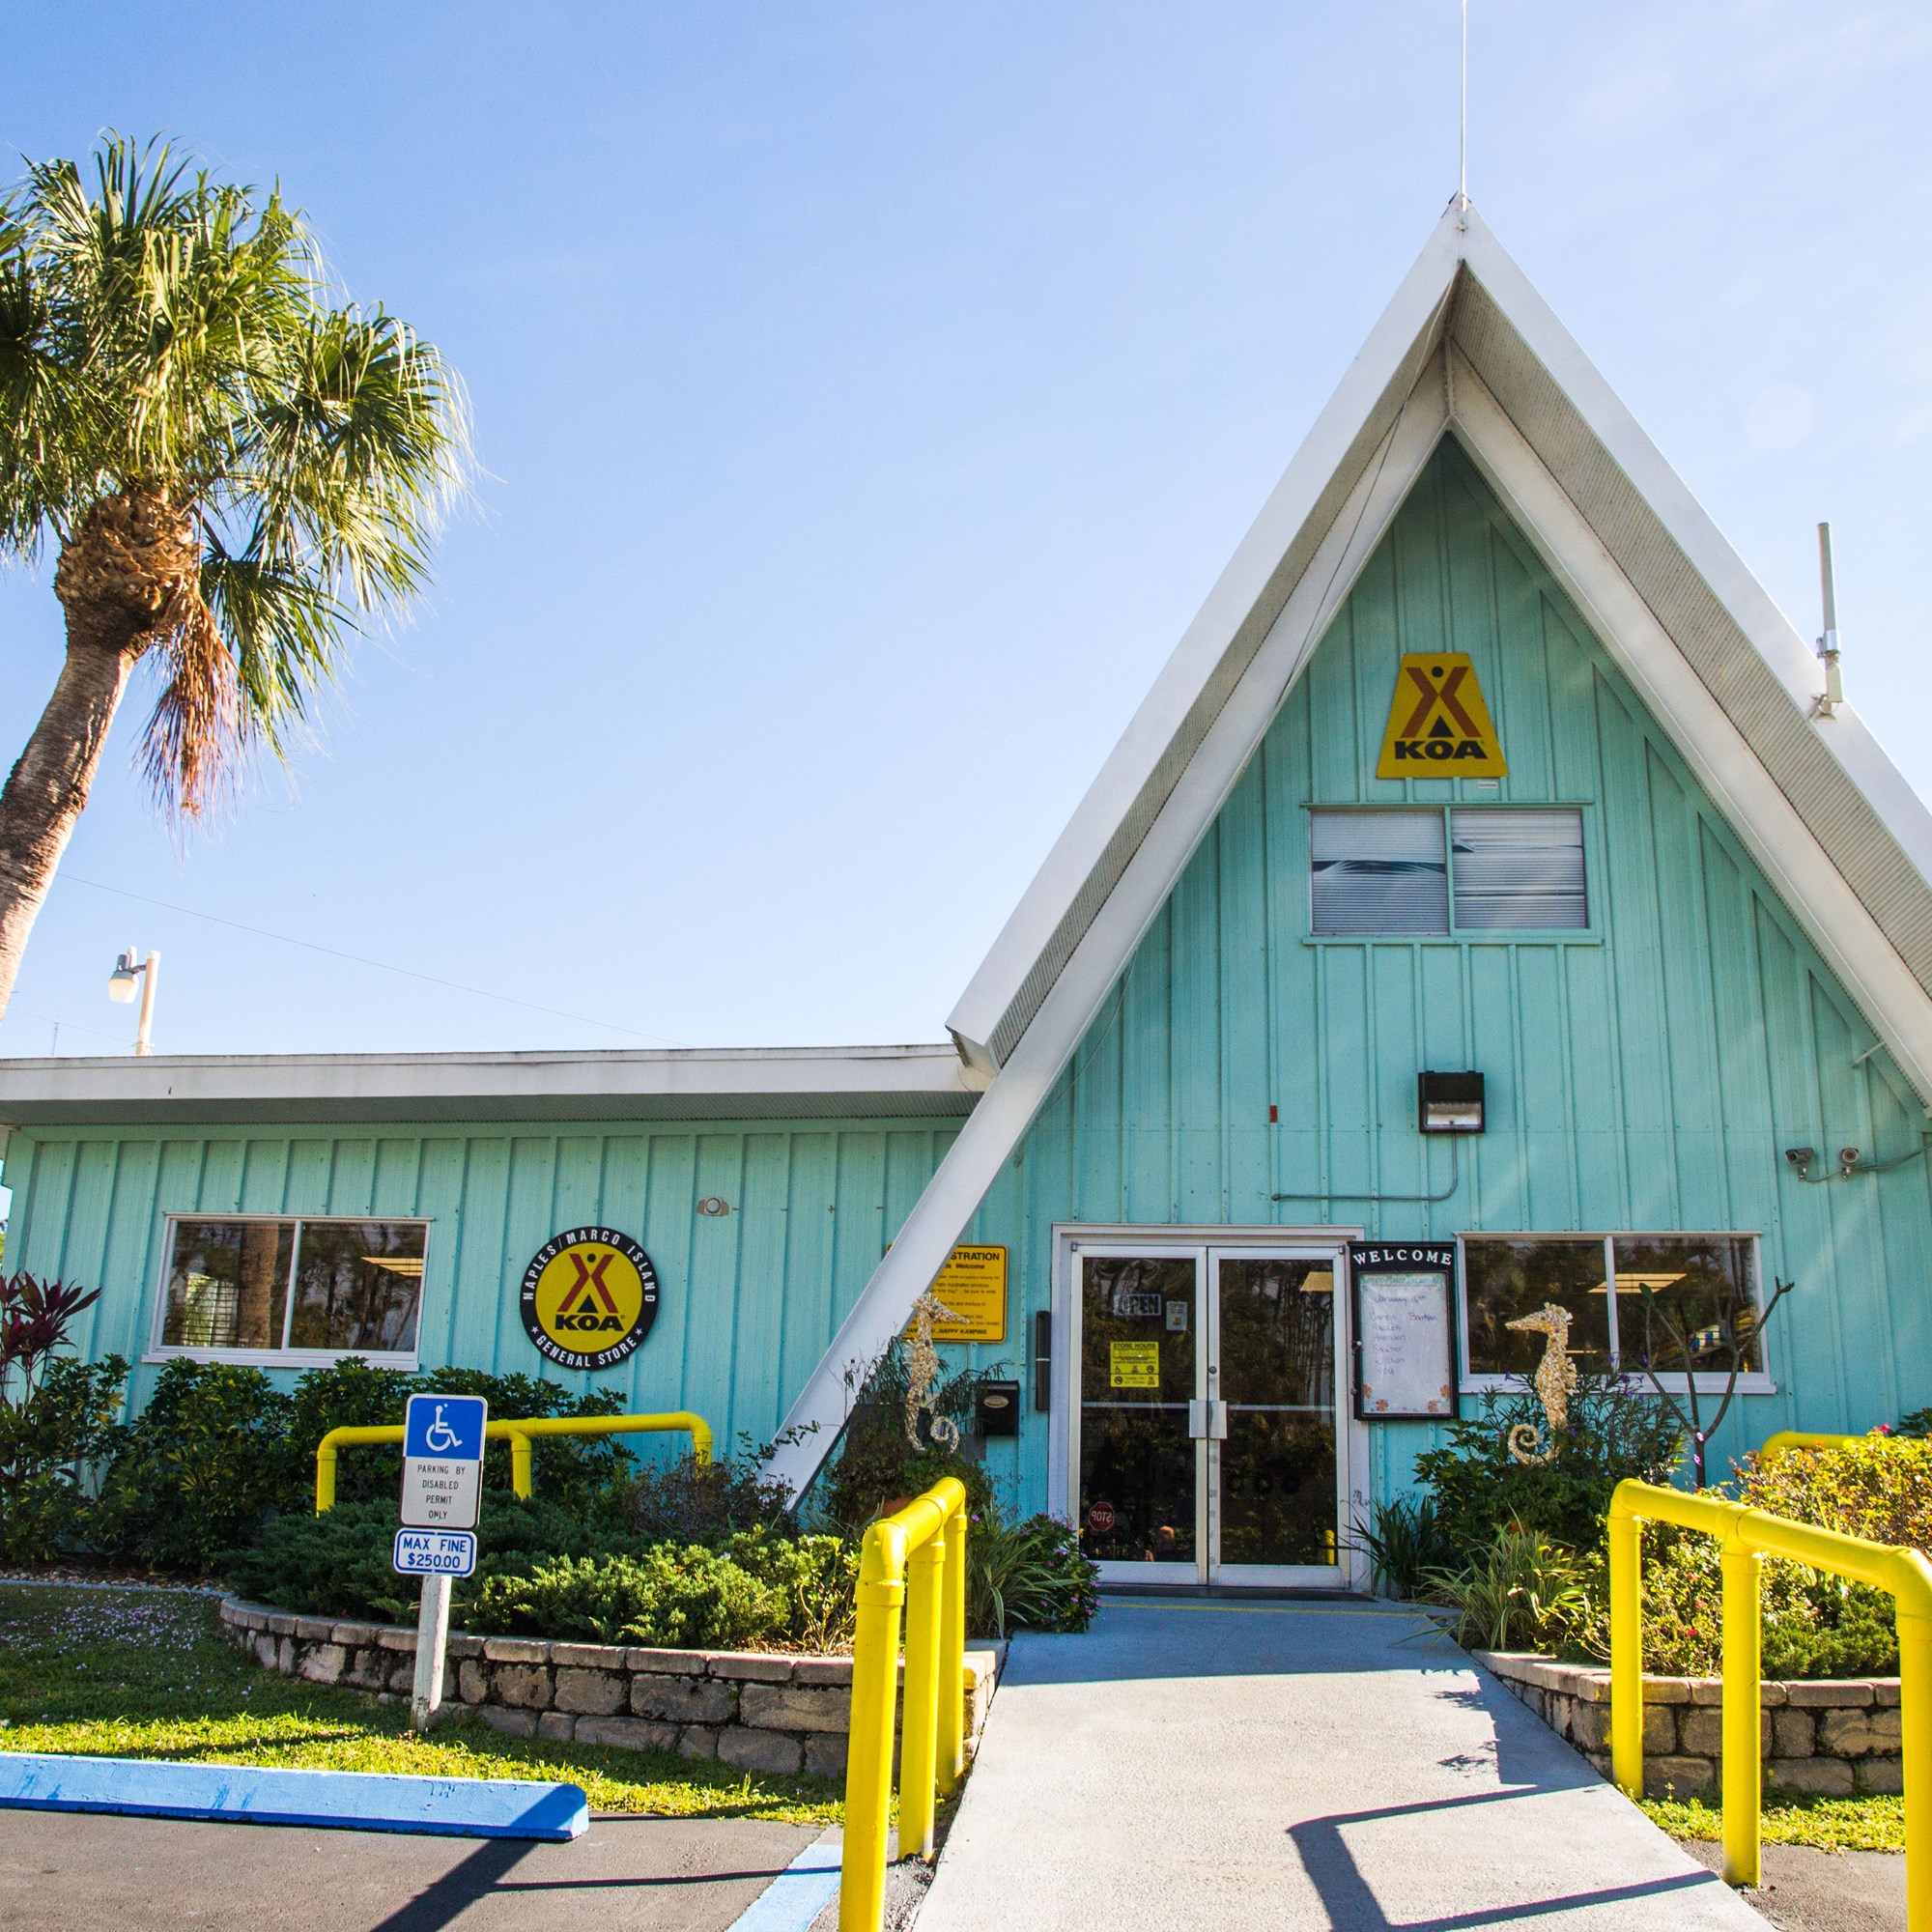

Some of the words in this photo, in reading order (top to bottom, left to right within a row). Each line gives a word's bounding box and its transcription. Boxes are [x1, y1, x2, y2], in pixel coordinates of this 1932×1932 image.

[1394, 740, 1489, 760] KOA
[951, 1252, 1000, 1261] STRATION
[1353, 1249, 1452, 1265] WELCOME
[627, 1245, 656, 1302] ISLAND
[1118, 1295, 1159, 1314] OPEN
[554, 1314, 625, 1332] KOA
[536, 1335, 591, 1367] GENERAL
[598, 1336, 638, 1366] STORE
[417, 1464, 449, 1475] PARKING
[456, 1465, 466, 1475] BY
[422, 1480, 459, 1490] DISABLED
[426, 1494, 452, 1505] PERMIT
[428, 1510, 448, 1520] ONLY
[403, 1537, 430, 1550] MAX
[440, 1539, 467, 1552] FINE
[408, 1552, 461, 1568] $250.00
